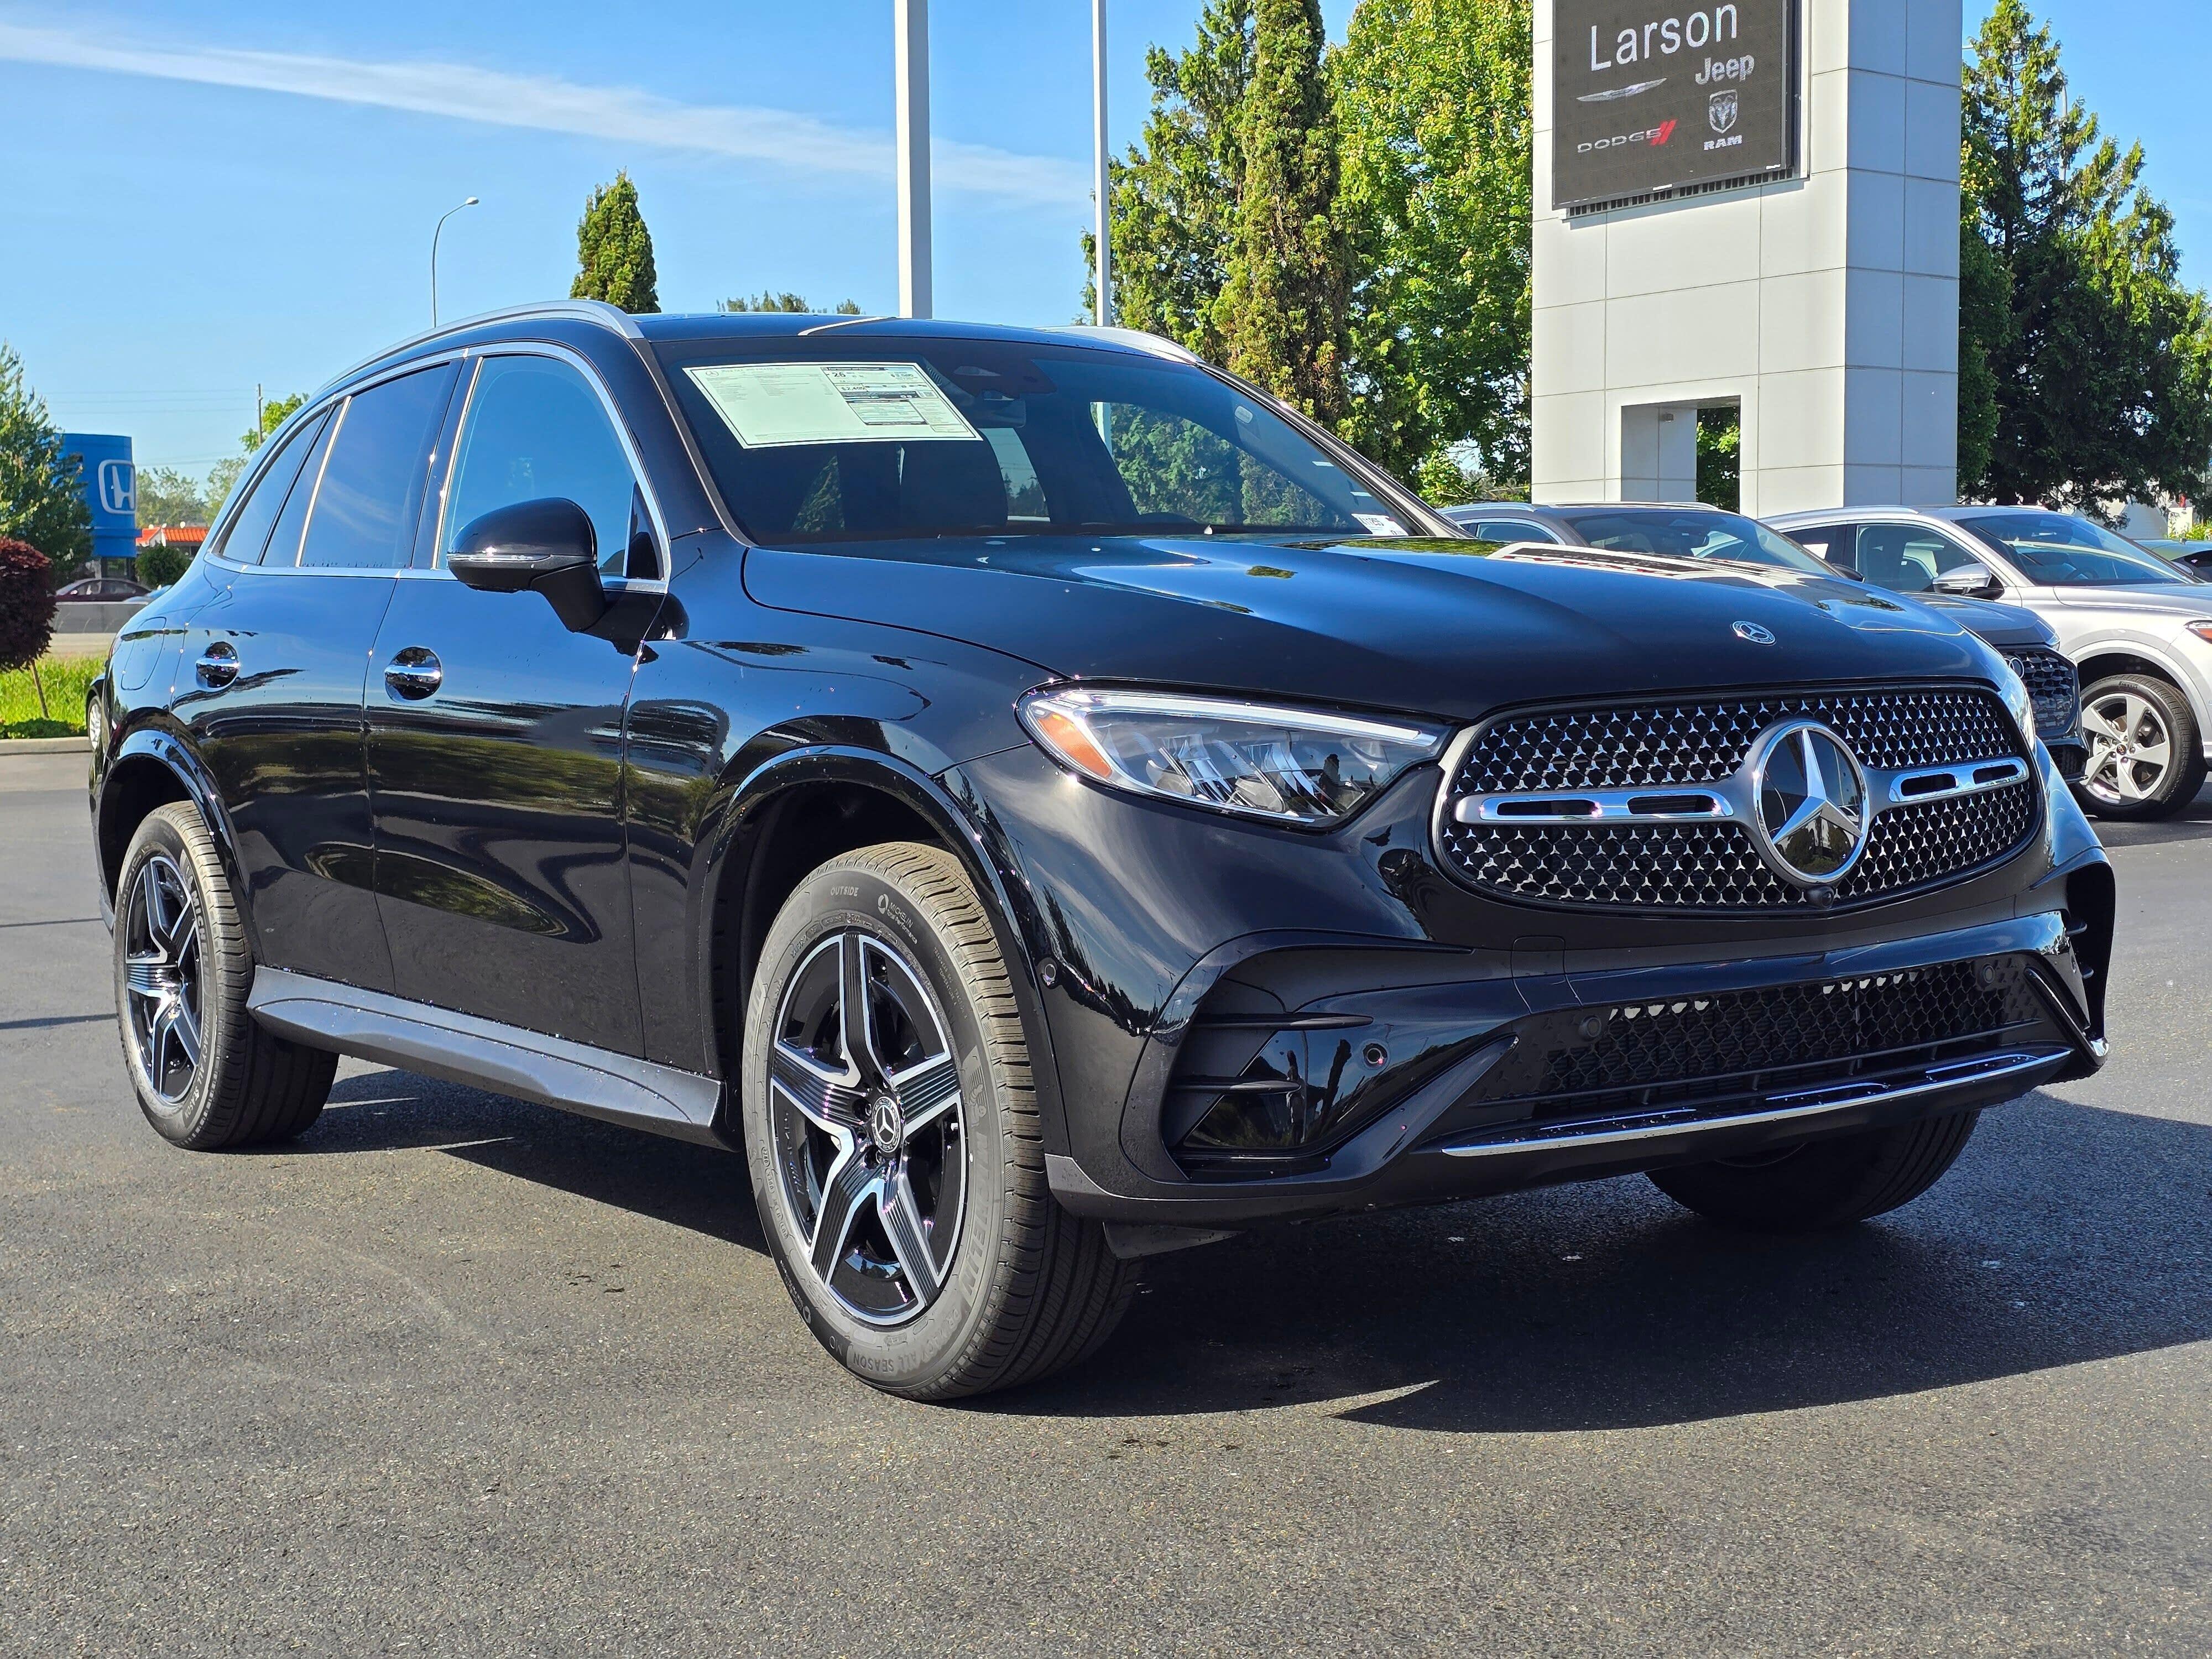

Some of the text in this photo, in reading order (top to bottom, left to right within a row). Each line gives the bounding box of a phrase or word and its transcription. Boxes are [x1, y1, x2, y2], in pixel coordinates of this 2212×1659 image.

[1591, 4, 1737, 71] Larson
[1695, 55, 1755, 86] Jeep
[1577, 127, 1662, 153] DODGE
[1704, 134, 1743, 151] RAM
[830, 886, 859, 897] OUTSIDE
[889, 902, 914, 928] MICHELIN
[191, 890, 210, 989] MICHELIN
[184, 1006, 210, 1120] PRIMACY ALL SEASON
[963, 1131, 989, 1296] MICHELIN
[828, 1335, 843, 1355] MO
[853, 1353, 894, 1373] SEASON
[898, 1351, 917, 1373] ALL
